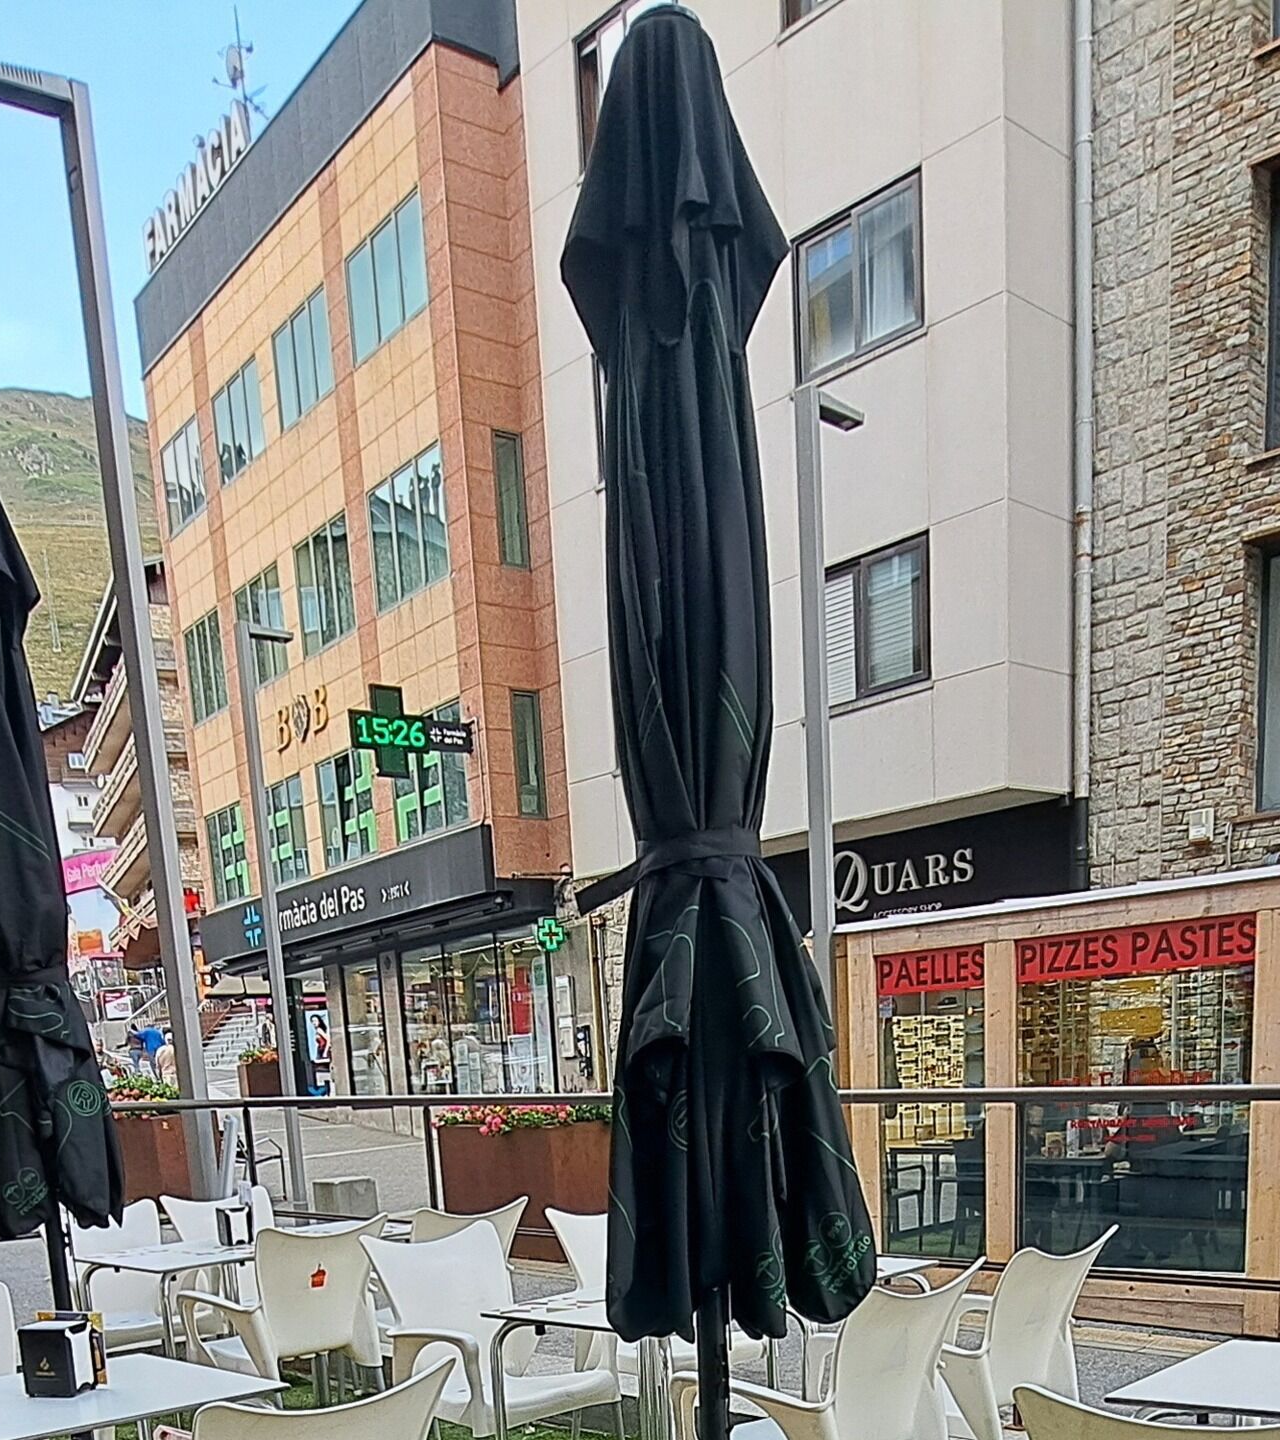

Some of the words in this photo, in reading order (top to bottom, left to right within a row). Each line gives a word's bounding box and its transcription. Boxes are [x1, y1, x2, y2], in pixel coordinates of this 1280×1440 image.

[356, 715, 427, 747] 15:26
[835, 848, 975, 913] QUARS
[319, 888, 339, 921] del
[341, 885, 366, 915] Pas
[1019, 934, 1119, 976] PIZZES
[1131, 917, 1256, 964] PASTES
[878, 948, 984, 990] PAELLES
